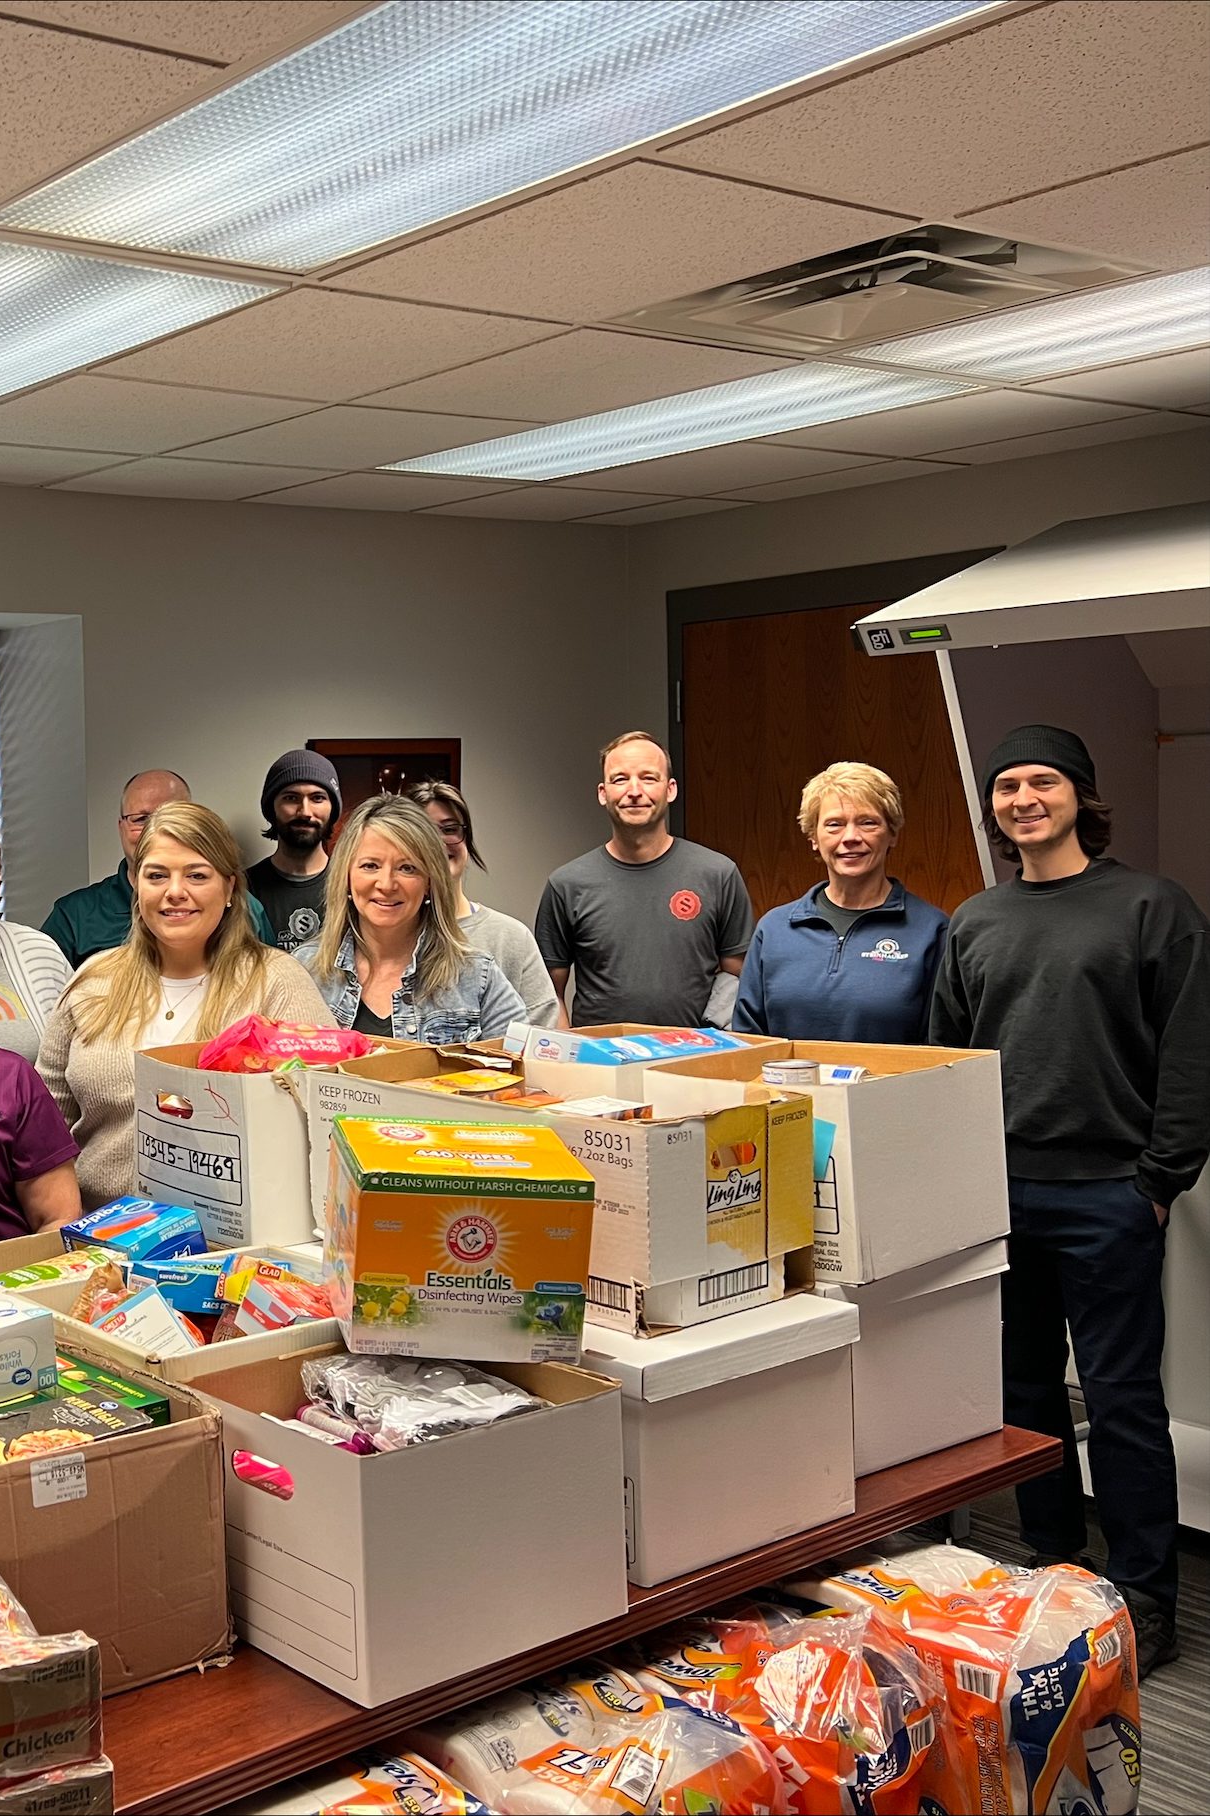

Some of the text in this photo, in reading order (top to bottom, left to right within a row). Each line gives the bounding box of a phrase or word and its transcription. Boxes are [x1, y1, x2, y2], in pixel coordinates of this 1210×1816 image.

[318, 1084, 341, 1099] KEEP
[343, 1088, 381, 1105] FROZEN
[320, 1100, 347, 1112] 982859
[771, 1110, 808, 1127] KEEP FROZEN
[584, 1129, 631, 1152] 85031
[607, 1152, 634, 1169] Bags
[381, 1177, 576, 1194] CLEANS WITHOUT HARSH CHEMICALS
[449, 1224, 461, 1243] ARM
[467, 1218, 494, 1245] HAMMER
[258, 1265, 280, 1278] GLAD
[217, 1273, 226, 1298] GLAD
[427, 1270, 512, 1291] Essentials
[202, 1300, 219, 1310] SACS
[418, 1289, 522, 1306] Disinfecting Wipes
[39, 1373, 56, 1387] 100
[604, 1690, 623, 1706] 150
[3, 1729, 77, 1759] Chicken
[1119, 1747, 1141, 1788] 150
[403, 1794, 421, 1814] 150
